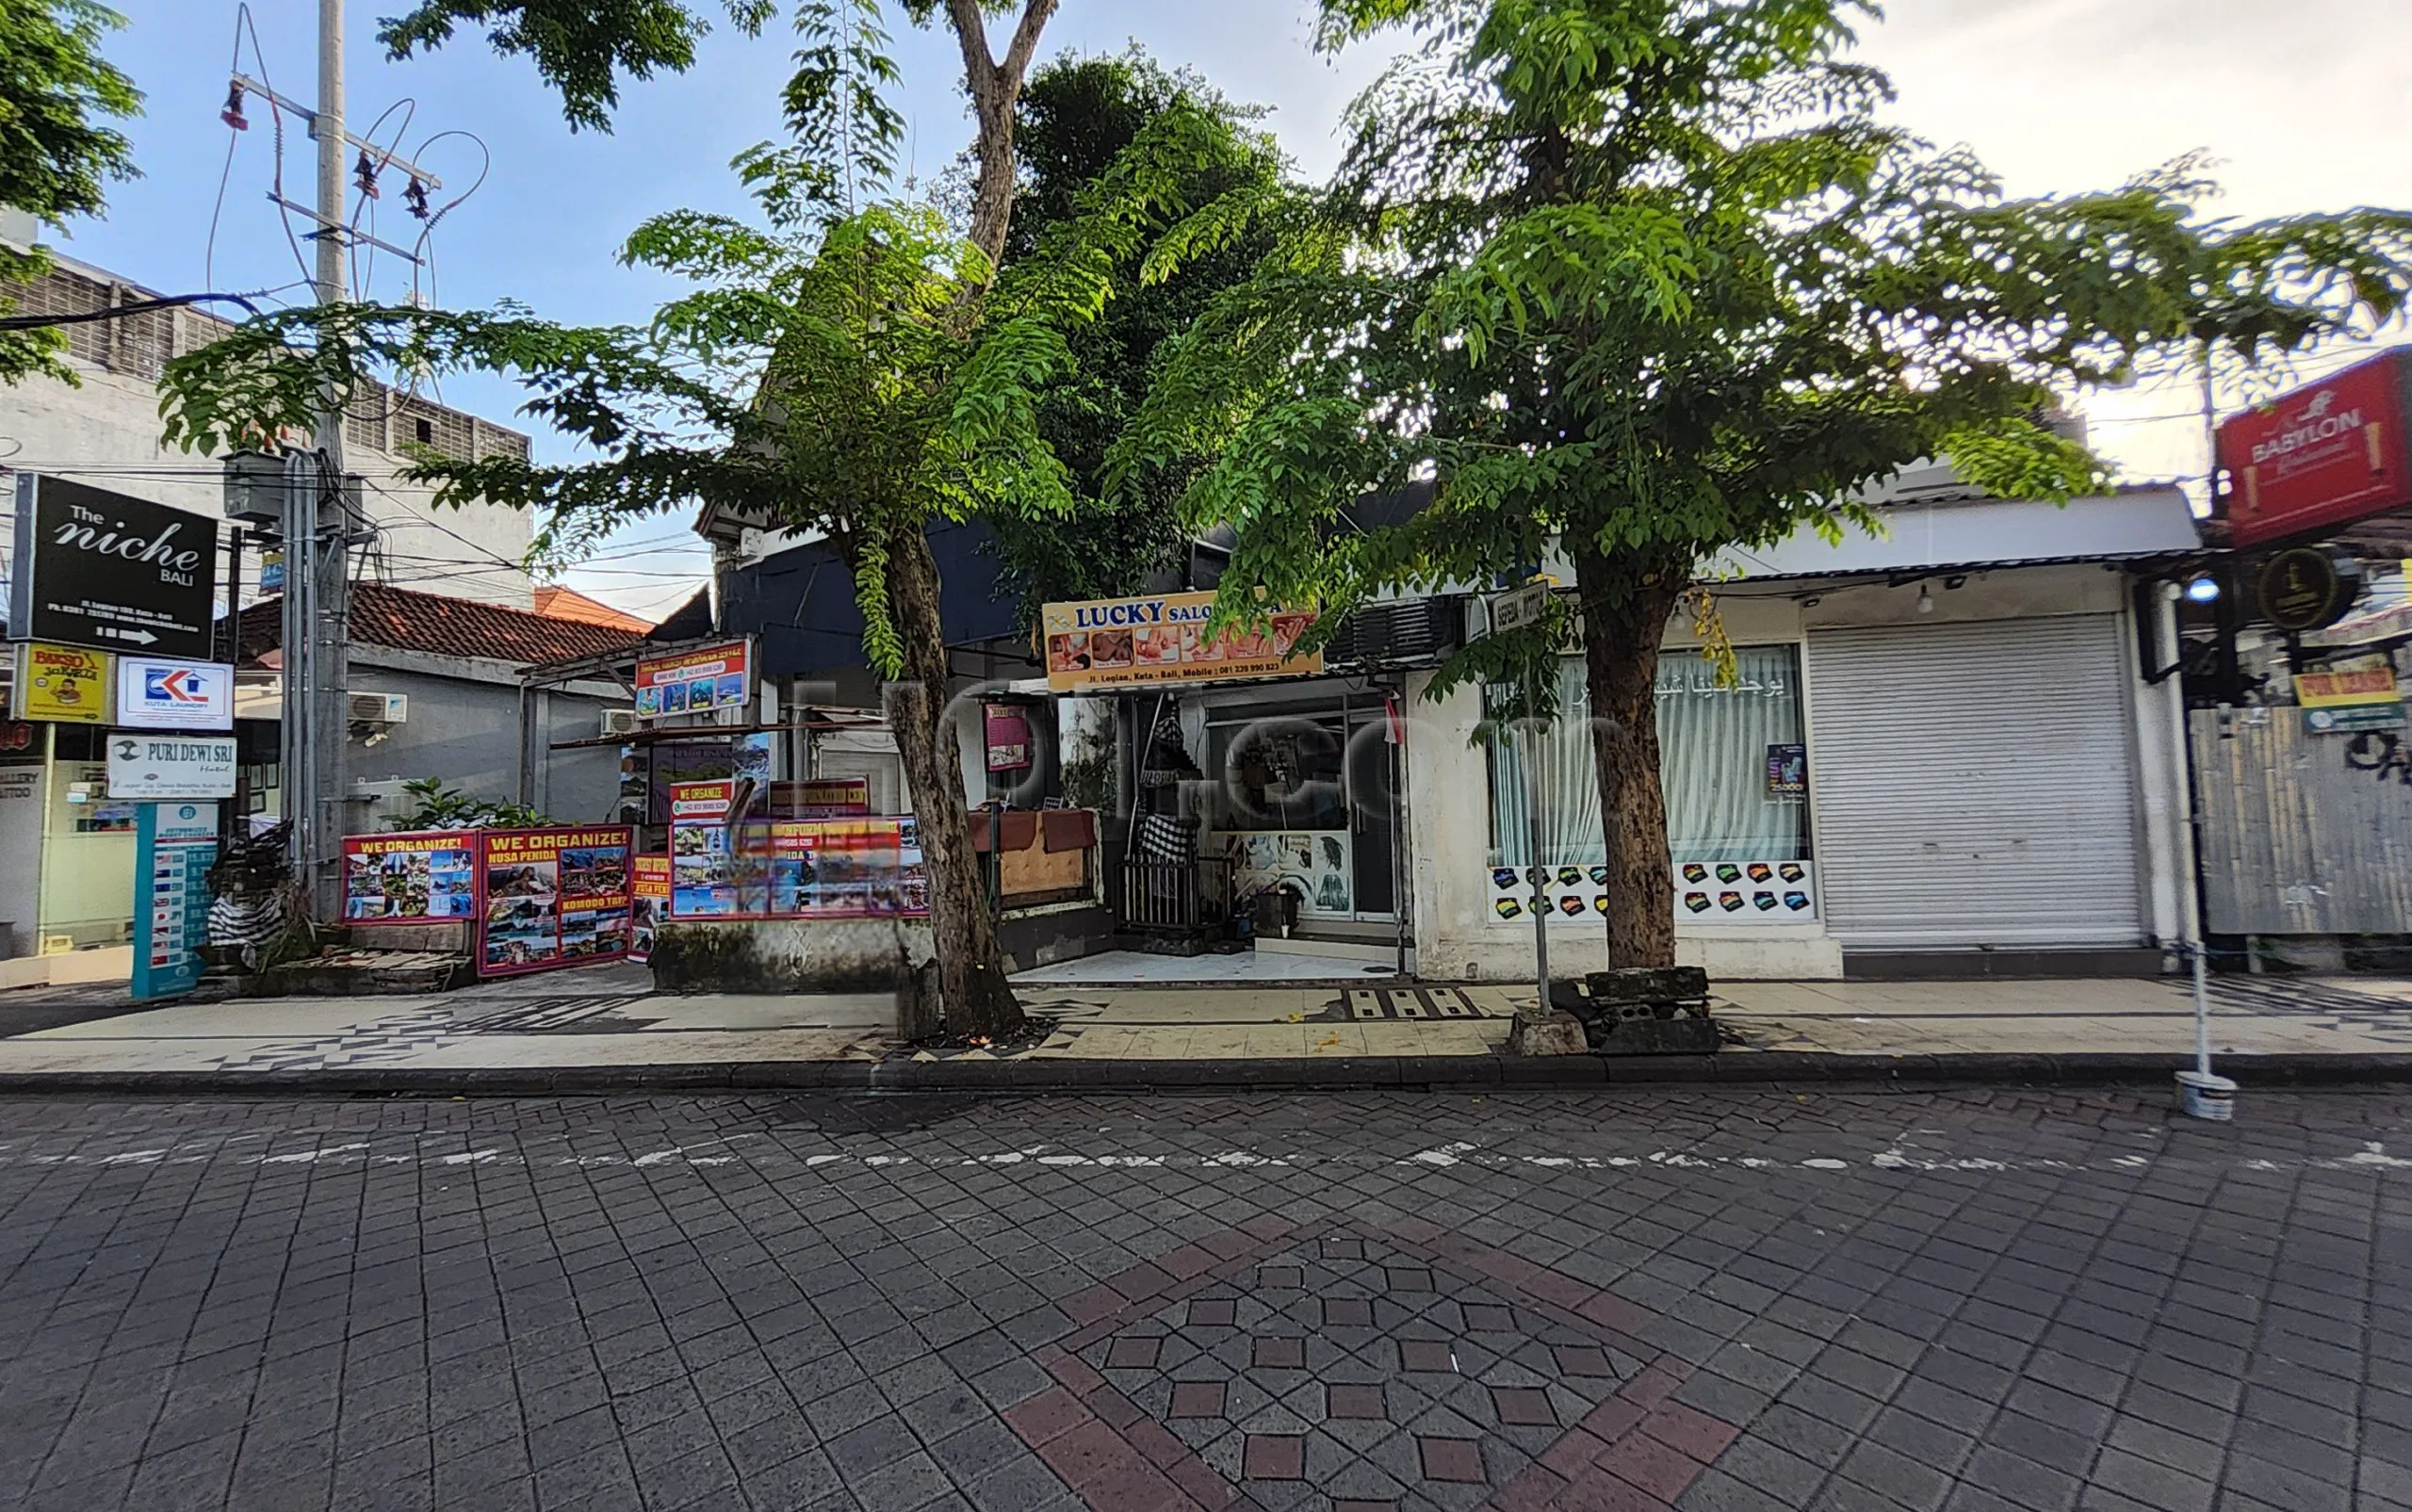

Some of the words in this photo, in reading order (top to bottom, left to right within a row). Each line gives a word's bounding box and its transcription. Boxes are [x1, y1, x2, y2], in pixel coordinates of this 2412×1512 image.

[2251, 408, 2362, 464] BABYLON
[70, 504, 106, 525] The
[53, 522, 201, 571] niche
[160, 569, 193, 587] BALI
[1076, 601, 1165, 628] LUCKY
[1168, 605, 1213, 622] SALO
[1134, 672, 1154, 681] Kuta
[1182, 668, 1213, 677] Mobile
[148, 742, 178, 762] PURI
[180, 743, 211, 762] DEWI
[214, 744, 233, 763] SRI
[361, 841, 383, 854] WE
[385, 837, 462, 853] ORGANIZE!
[491, 837, 524, 851] WE
[530, 832, 627, 849] ORGANIZE!
[488, 852, 517, 864] NUSA
[520, 850, 557, 861] PENIDA
[562, 898, 605, 911] KOMODO
